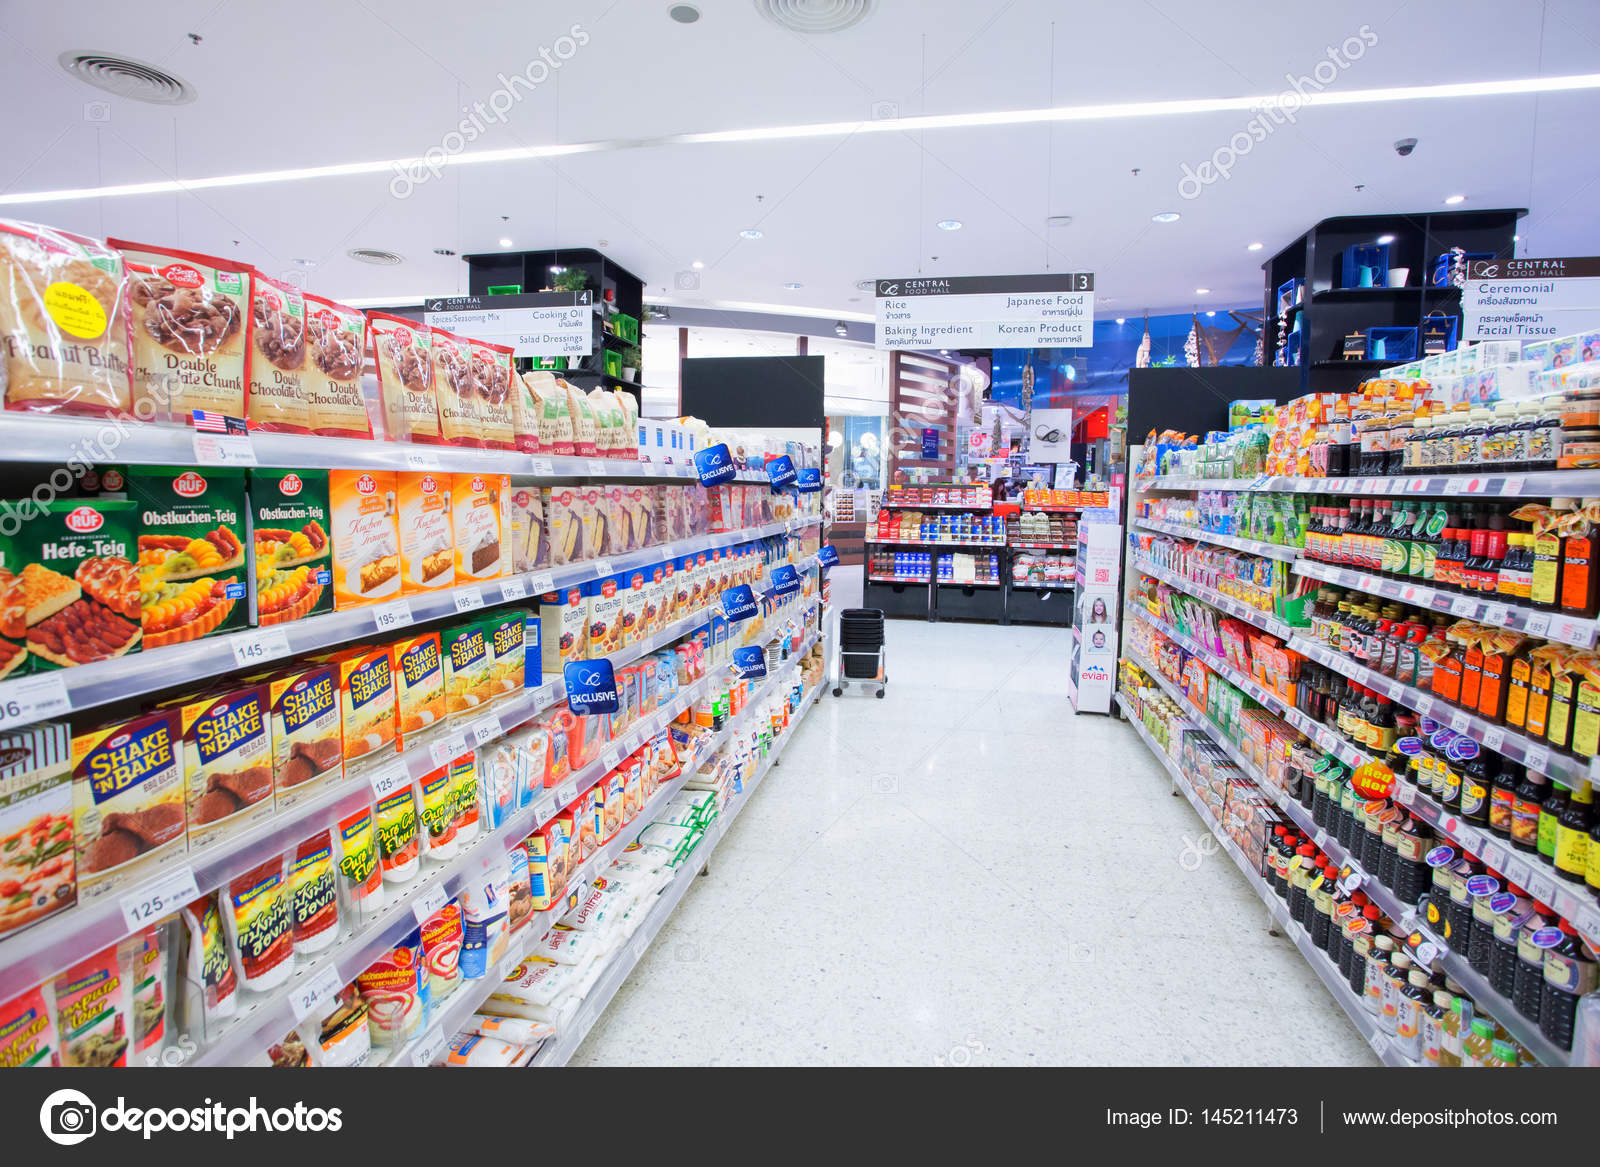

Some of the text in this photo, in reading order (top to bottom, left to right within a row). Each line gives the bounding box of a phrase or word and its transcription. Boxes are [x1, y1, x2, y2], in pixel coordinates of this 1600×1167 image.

[1507, 261, 1566, 270] CENTRAL
[1540, 269, 1566, 277] HALL
[905, 280, 951, 288] CENTRAL
[1079, 275, 1089, 290] 3
[1478, 283, 1554, 294] Ceremonial
[446, 297, 481, 305] CENTRAL
[579, 293, 588, 305] 4
[885, 300, 907, 309] Rice
[1007, 295, 1084, 309] Japanese Food
[488, 312, 501, 322] Mix
[532, 309, 584, 321] Cooking Oil
[885, 324, 973, 337] Baking Ingredient
[998, 323, 1083, 334] Korean Product
[1477, 325, 1557, 335] Facial Tissue
[519, 334, 583, 345] Salad Dressings
[164, 353, 217, 373] Double
[203, 373, 243, 391] Chunk
[328, 380, 359, 395] Double
[249, 382, 296, 399] Chocolate
[308, 391, 352, 406] Chocolate
[701, 463, 734, 481] EXCLUSIVE
[771, 469, 797, 485] EXCLUSIVE
[178, 479, 203, 491] RUF
[282, 480, 300, 492] RUF
[358, 480, 375, 492] RUF
[421, 480, 437, 492] RUF
[471, 480, 485, 492] RUF
[71, 514, 99, 528] RUF
[142, 508, 237, 527] Obstkuchen-Teig
[259, 506, 324, 522] Obstkuchen-Teig
[42, 540, 126, 561] Hefe-Teig
[775, 578, 800, 592] EXCLUSIVE
[457, 597, 471, 609] 195
[727, 601, 756, 617] EXCLUSIVE
[379, 613, 396, 627] 195
[494, 621, 523, 645] SHAKE
[452, 632, 484, 659] SHAKE
[503, 632, 522, 651] BAKE
[238, 643, 264, 659] 145
[403, 643, 437, 673] SHAKE
[461, 644, 485, 666] BAKE
[413, 657, 439, 681] BAKE
[741, 663, 766, 672] XCLUSIVE
[351, 660, 389, 693] SHAKE
[1082, 672, 1109, 681] evian
[363, 673, 390, 701] BAKE
[283, 677, 332, 714] SHAKE
[570, 690, 616, 705] EXCLUSIVE
[297, 694, 334, 724] BAKE
[196, 700, 259, 742] SHAKE
[215, 719, 263, 754] BAKE
[476, 726, 490, 739] 125
[90, 727, 169, 780] SHAKE
[114, 746, 172, 791] BAKE
[1363, 764, 1392, 783] Red
[144, 766, 178, 793] BBQ GLAZE
[375, 777, 393, 793] 125
[1361, 777, 1387, 794] Hot
[421, 806, 445, 828] Pure
[376, 825, 400, 847] Pure
[385, 828, 416, 854] Flour
[340, 852, 367, 874] Pure
[239, 874, 281, 904] McGarrett
[131, 896, 164, 921] 125
[302, 990, 318, 1009] 24
[70, 1000, 108, 1030] lour
